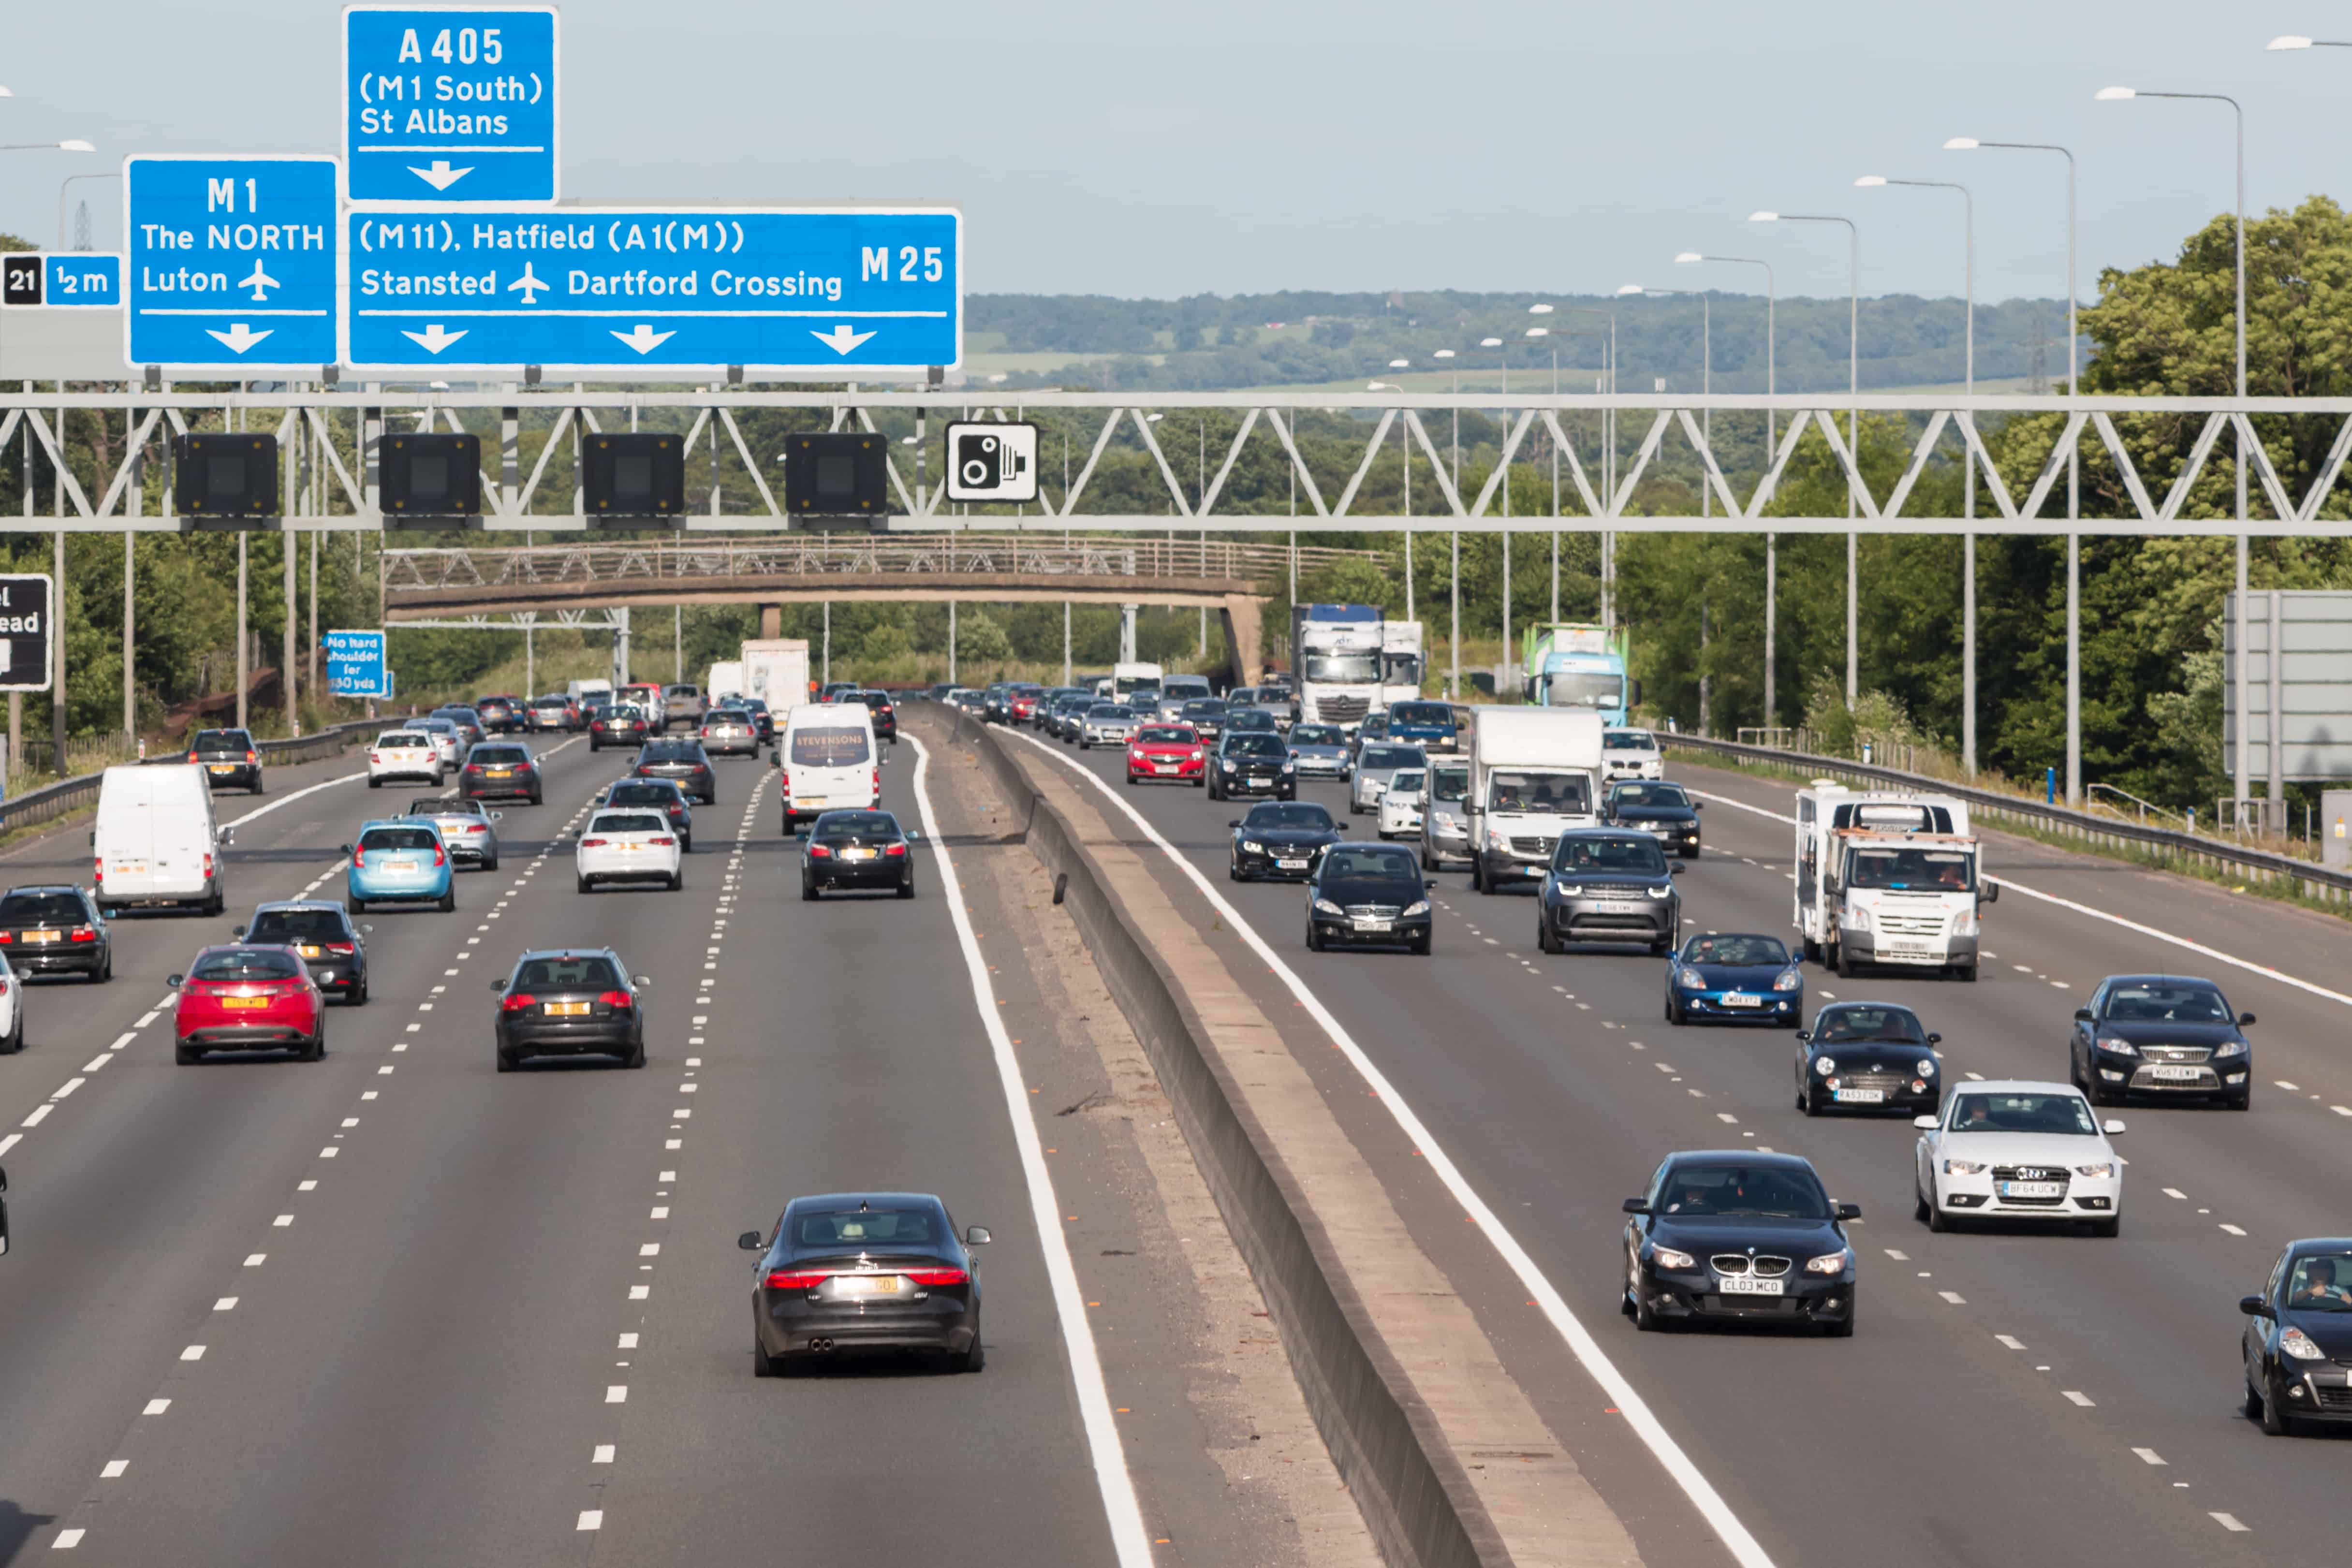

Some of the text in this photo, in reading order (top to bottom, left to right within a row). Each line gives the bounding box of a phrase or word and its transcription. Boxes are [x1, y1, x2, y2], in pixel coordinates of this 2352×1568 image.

[435, 73, 542, 104] South)
[361, 108, 508, 135] St Albans
[140, 224, 323, 250] The NORTH
[360, 220, 744, 253] (M11), Hatfield (A1(M))
[10, 269, 34, 291] 21
[83, 274, 107, 292] m
[143, 266, 227, 292] Luton
[361, 269, 841, 301] Stansted Dartford Crossing
[328, 637, 378, 648] No hard
[344, 663, 361, 674] for
[354, 677, 375, 690] yds
[796, 734, 863, 746] STEVENSONS
[2011, 1183, 2034, 1193] BF64
